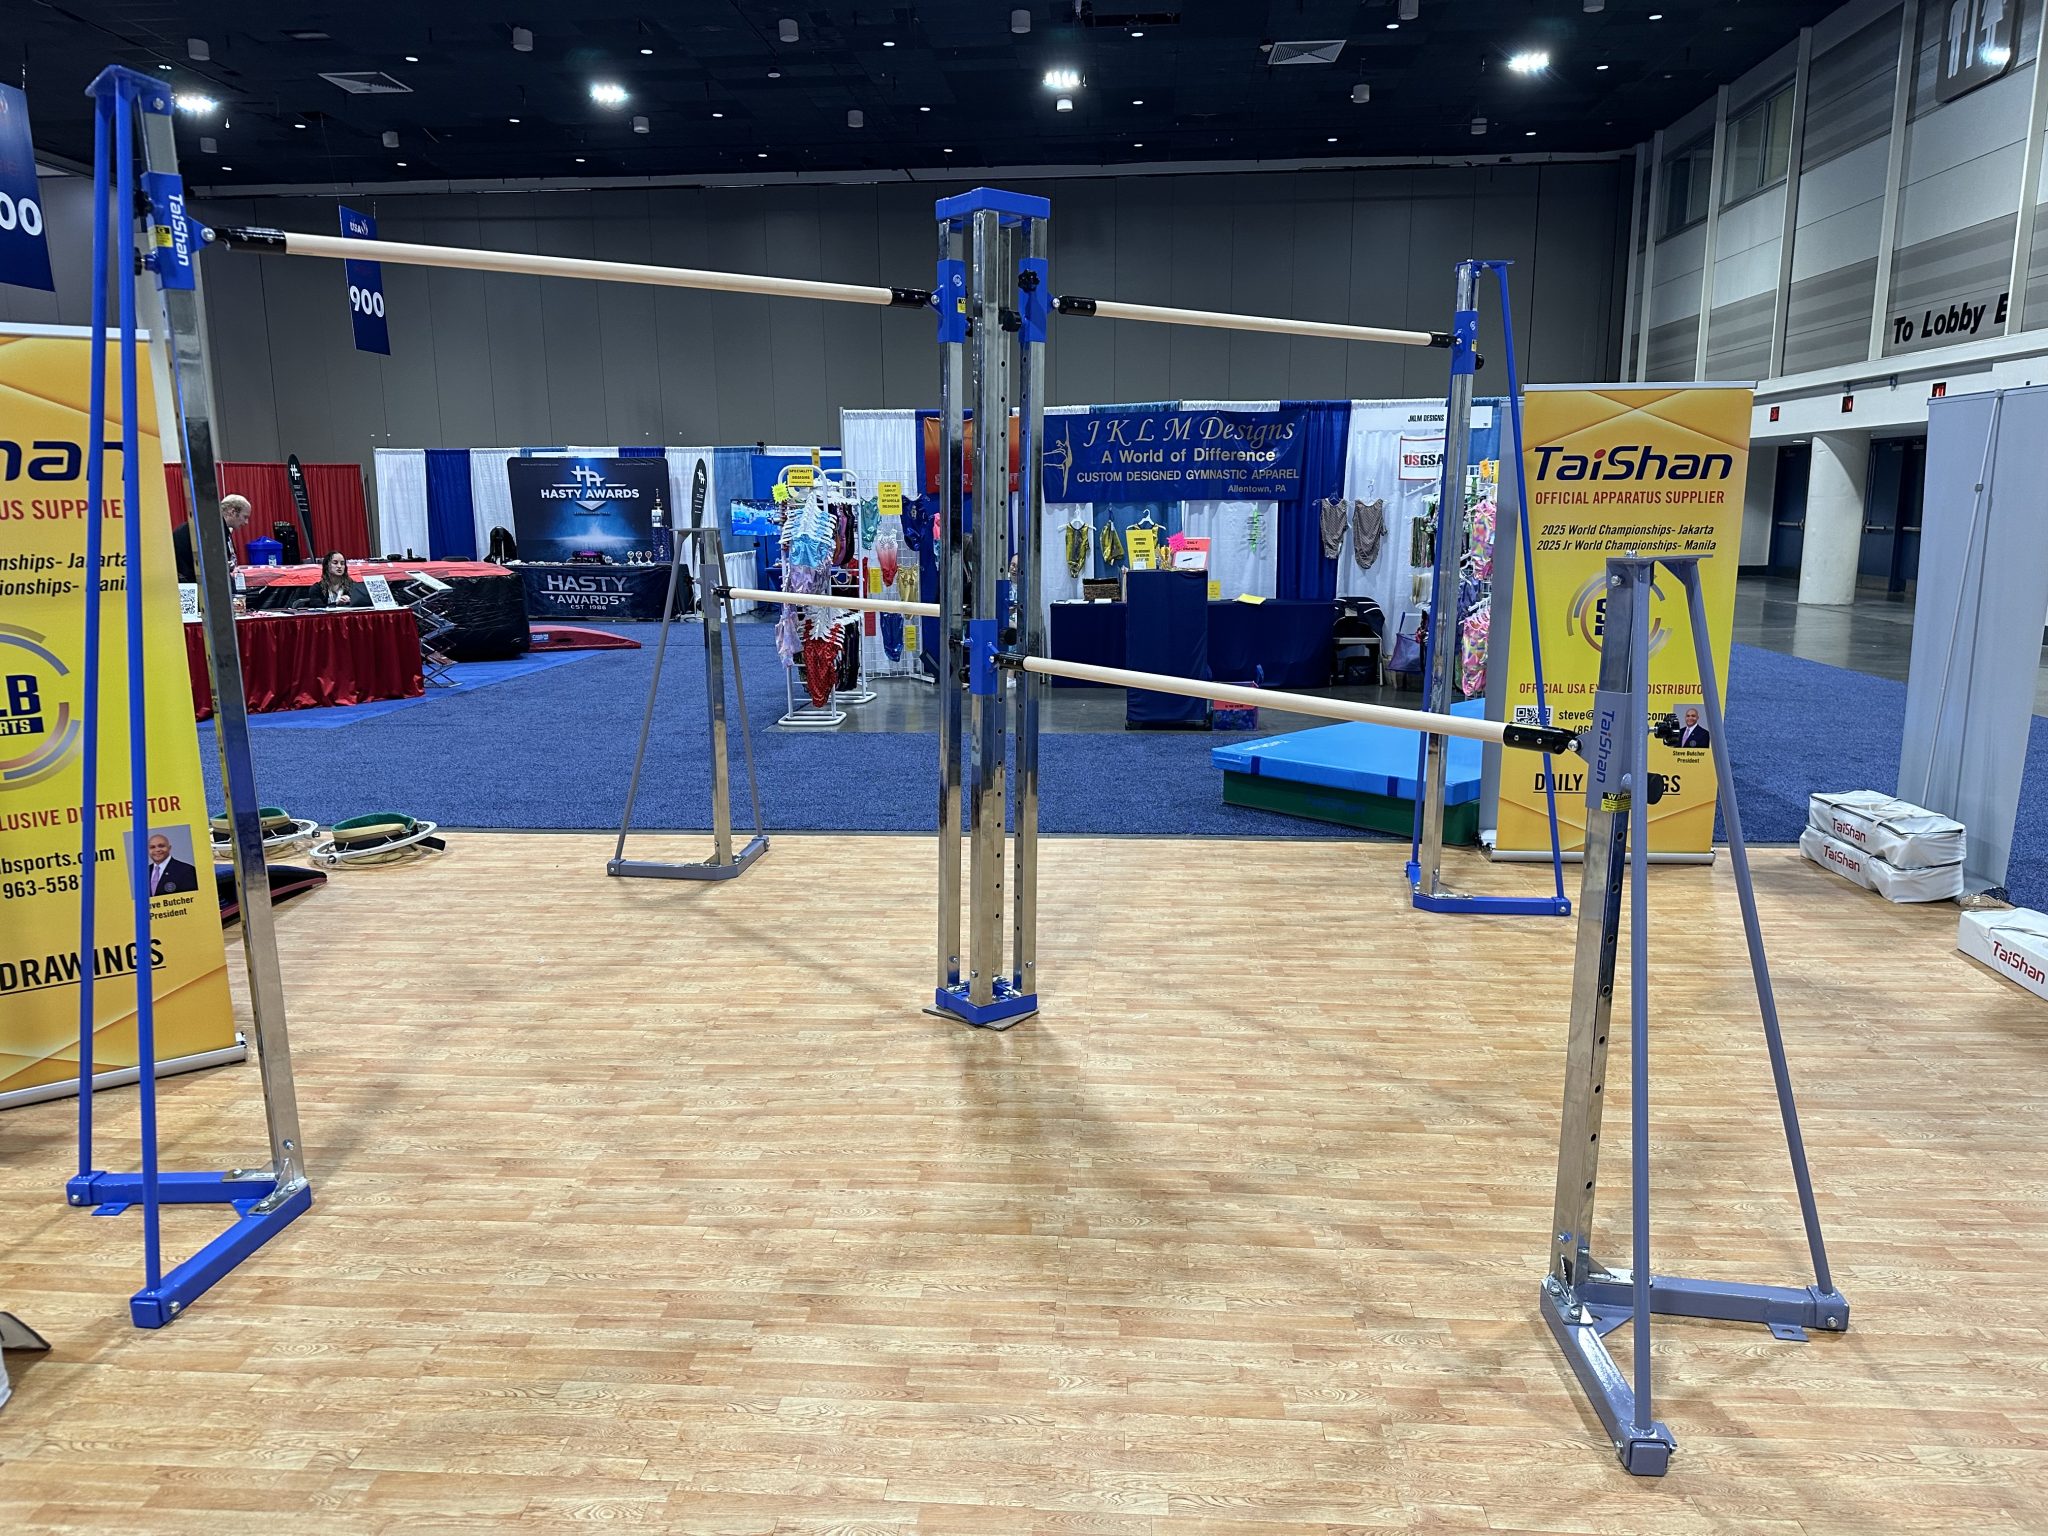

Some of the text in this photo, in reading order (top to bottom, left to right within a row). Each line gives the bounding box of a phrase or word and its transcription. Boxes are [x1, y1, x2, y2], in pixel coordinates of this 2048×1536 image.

[168, 194, 190, 267] TaiShan
[350, 285, 385, 318] 900
[1894, 316, 1914, 344] To
[1921, 302, 1987, 338] Lobby
[1200, 416, 1295, 449] Designs
[1101, 447, 1276, 464] A World of Difference
[1534, 446, 1733, 480] TaiShan
[1076, 469, 1300, 483] CUSTOM DESIGNED GYMNASTIC APPAREL
[541, 489, 640, 499] HASTY AWARDS
[1227, 484, 1287, 495] Allentown, PA
[1535, 490, 1725, 505] OFFICIAL APPARATUS SUPPLIER
[1541, 525, 1714, 537] 2025 World Championships- Jakarta
[1537, 540, 1716, 552] 2025 Jr World Championships- Manila
[68, 553, 127, 568] Jaarta
[547, 575, 628, 592] HASTY
[556, 595, 620, 605] AWARDS
[1519, 684, 1563, 694] OFFCIAL
[1567, 684, 1586, 694] USA
[1648, 684, 1703, 695] DISTRIBUTO
[1596, 711, 1615, 783] TaiShan
[67, 795, 182, 824] DITRIBTOR
[1832, 818, 1866, 843] TaiShan
[1824, 845, 1860, 872] TaiShan
[163, 896, 194, 909] Butcher
[149, 908, 187, 920] President
[1994, 941, 2046, 985] TaiShan
